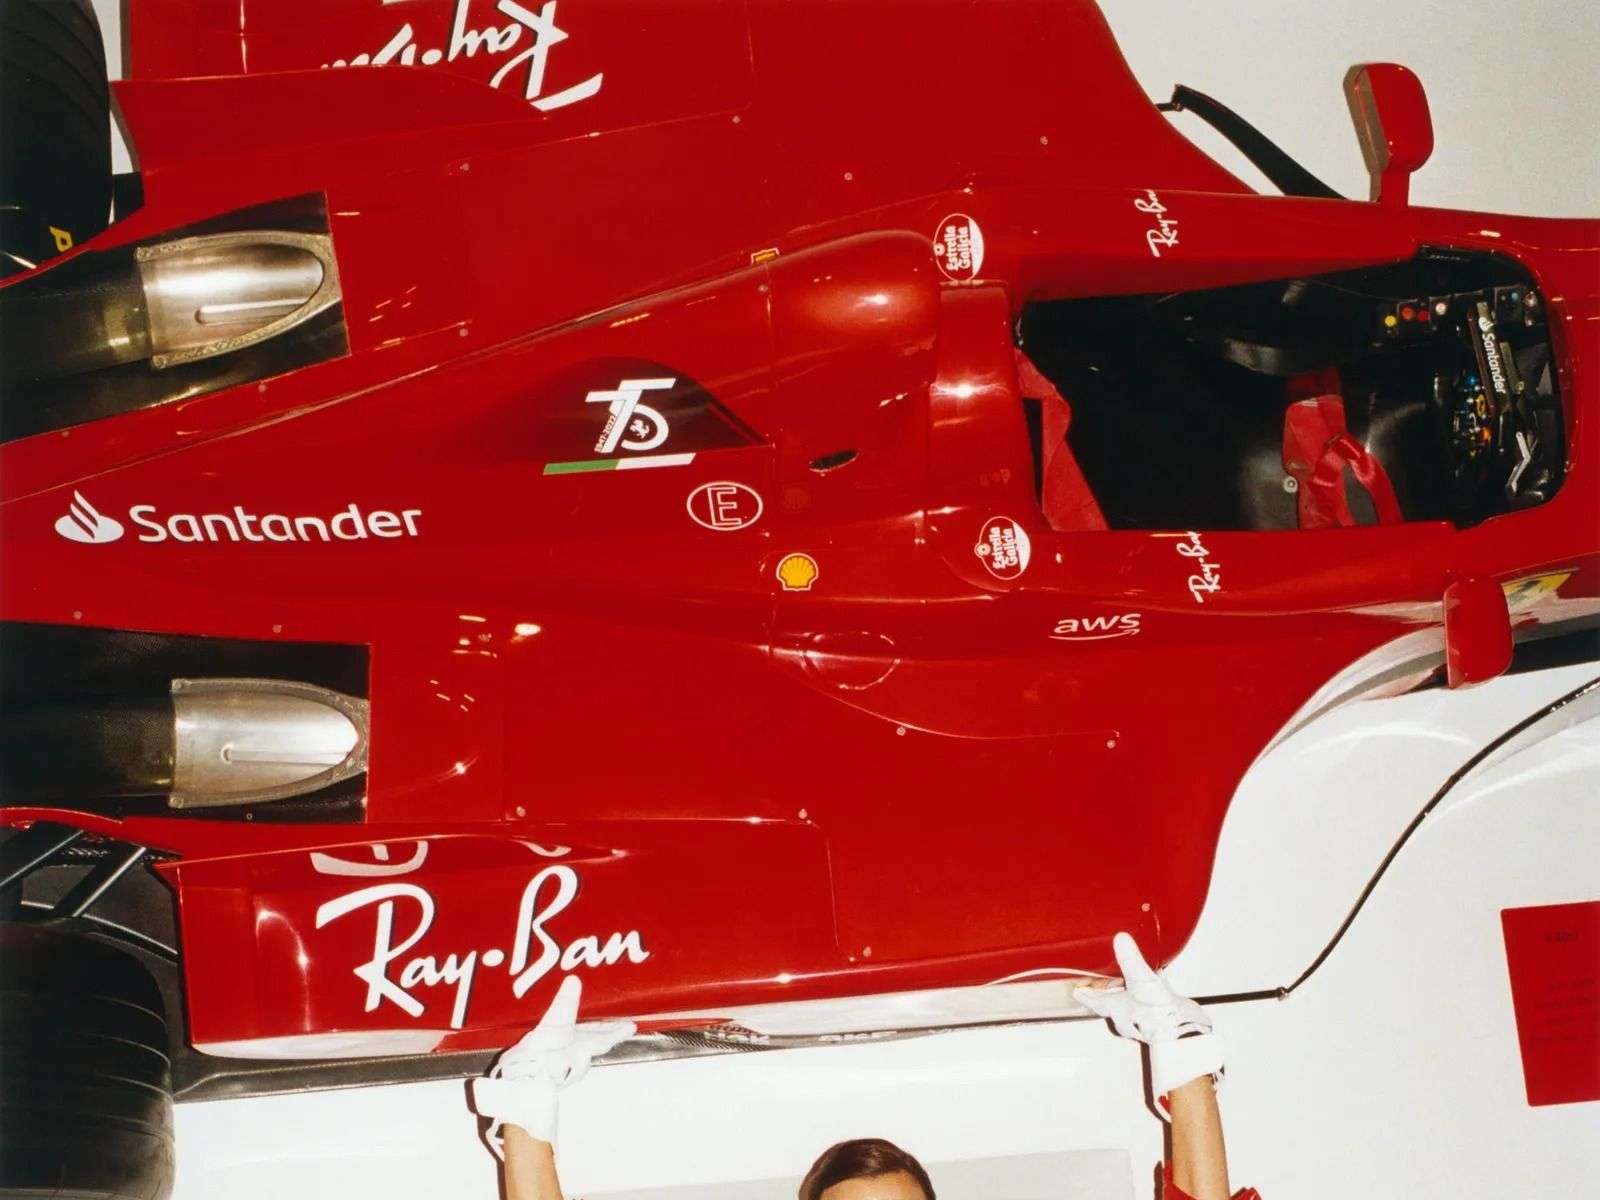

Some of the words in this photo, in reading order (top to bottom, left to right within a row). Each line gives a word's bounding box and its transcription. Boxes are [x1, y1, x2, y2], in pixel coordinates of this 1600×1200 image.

[1482, 332, 1507, 394] Santander
[129, 503, 422, 543] Santander
[707, 486, 742, 526] E
[1053, 612, 1142, 634] aws
